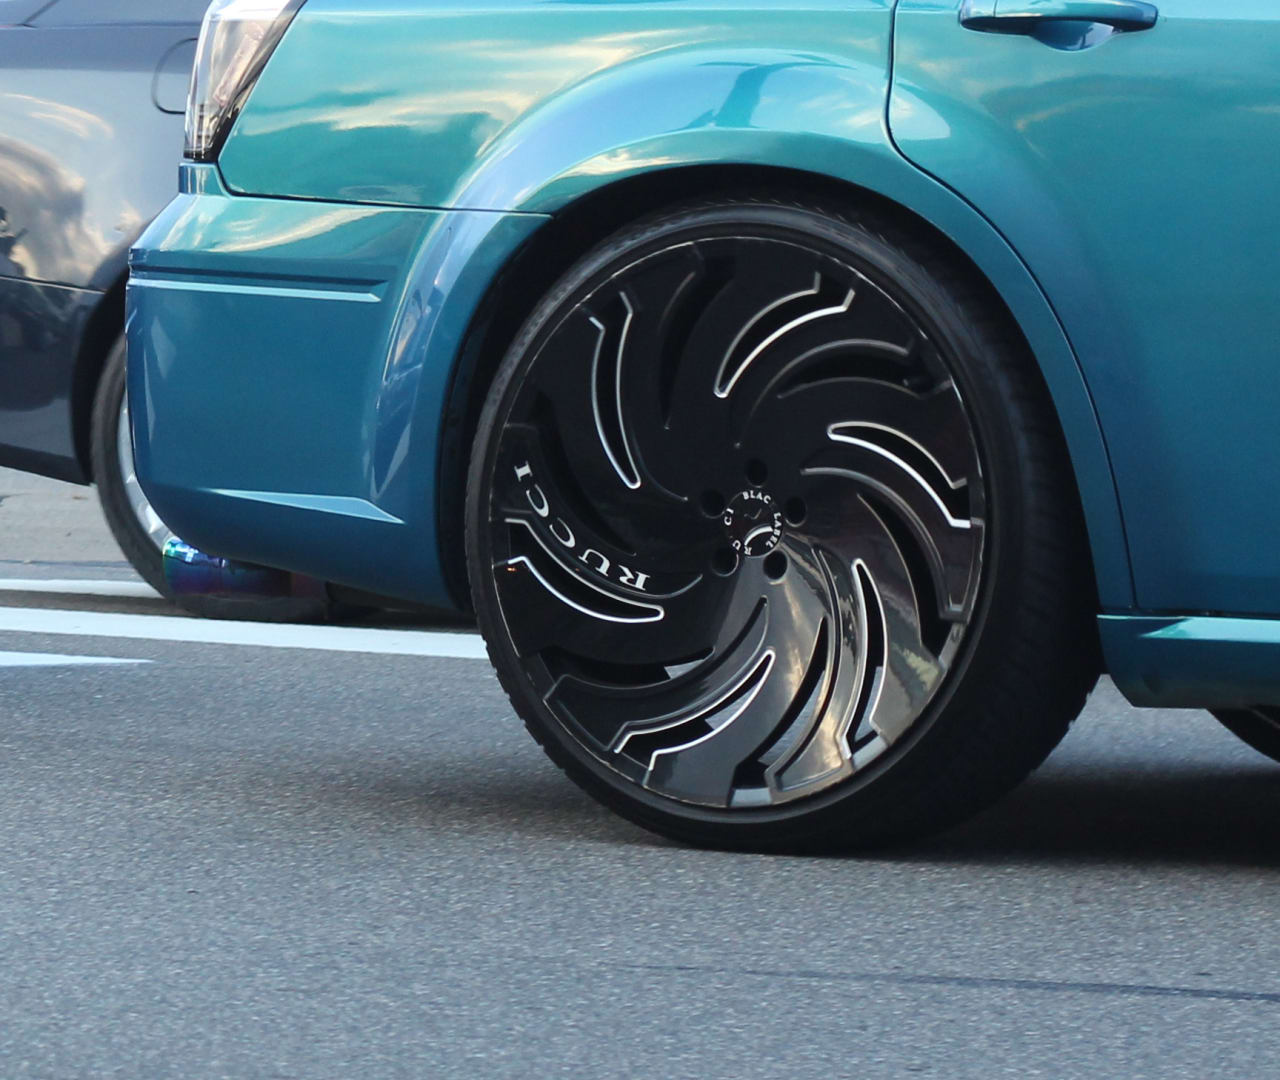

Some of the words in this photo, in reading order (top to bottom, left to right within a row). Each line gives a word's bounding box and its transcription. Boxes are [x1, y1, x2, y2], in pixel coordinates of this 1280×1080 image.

[513, 460, 651, 591] RUCCI
[742, 490, 773, 506] BLAC
[764, 512, 782, 548] LABEL
